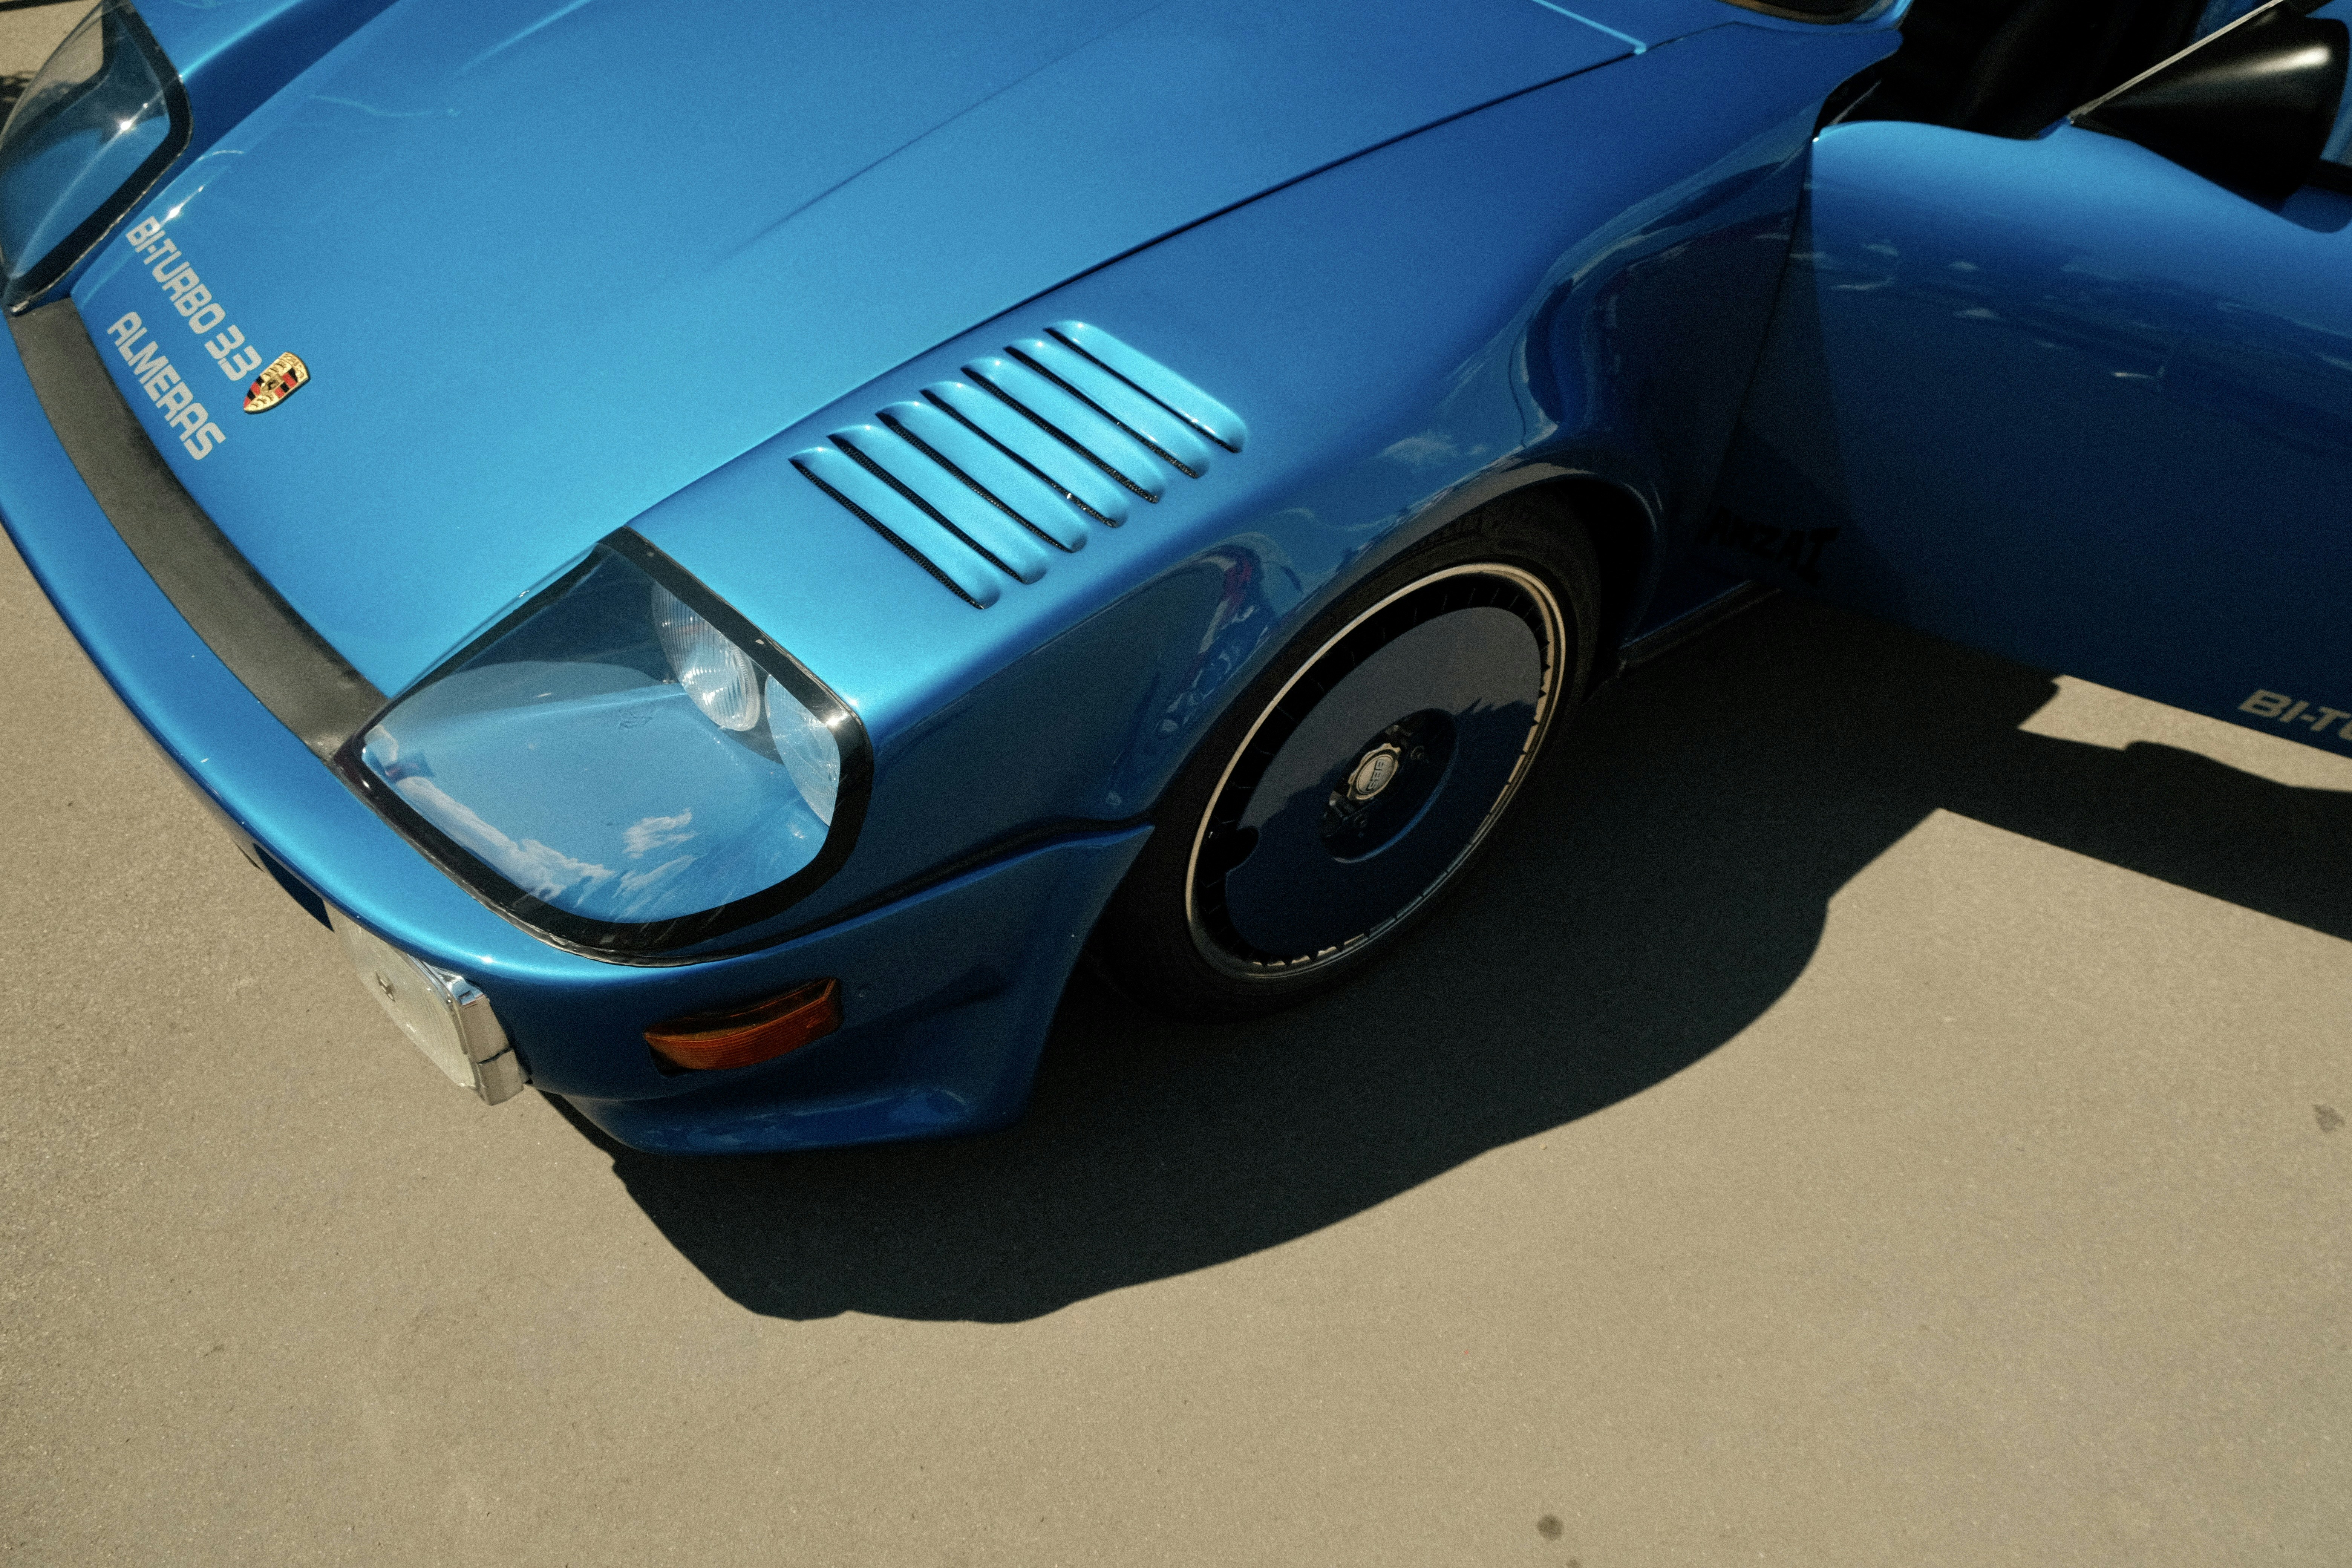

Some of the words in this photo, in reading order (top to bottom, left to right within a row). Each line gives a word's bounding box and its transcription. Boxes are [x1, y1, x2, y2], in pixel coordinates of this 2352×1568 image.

[126, 216, 225, 334] BI-TURBO
[107, 311, 226, 460] ALMERAS
[1367, 758, 1387, 791] BBS
